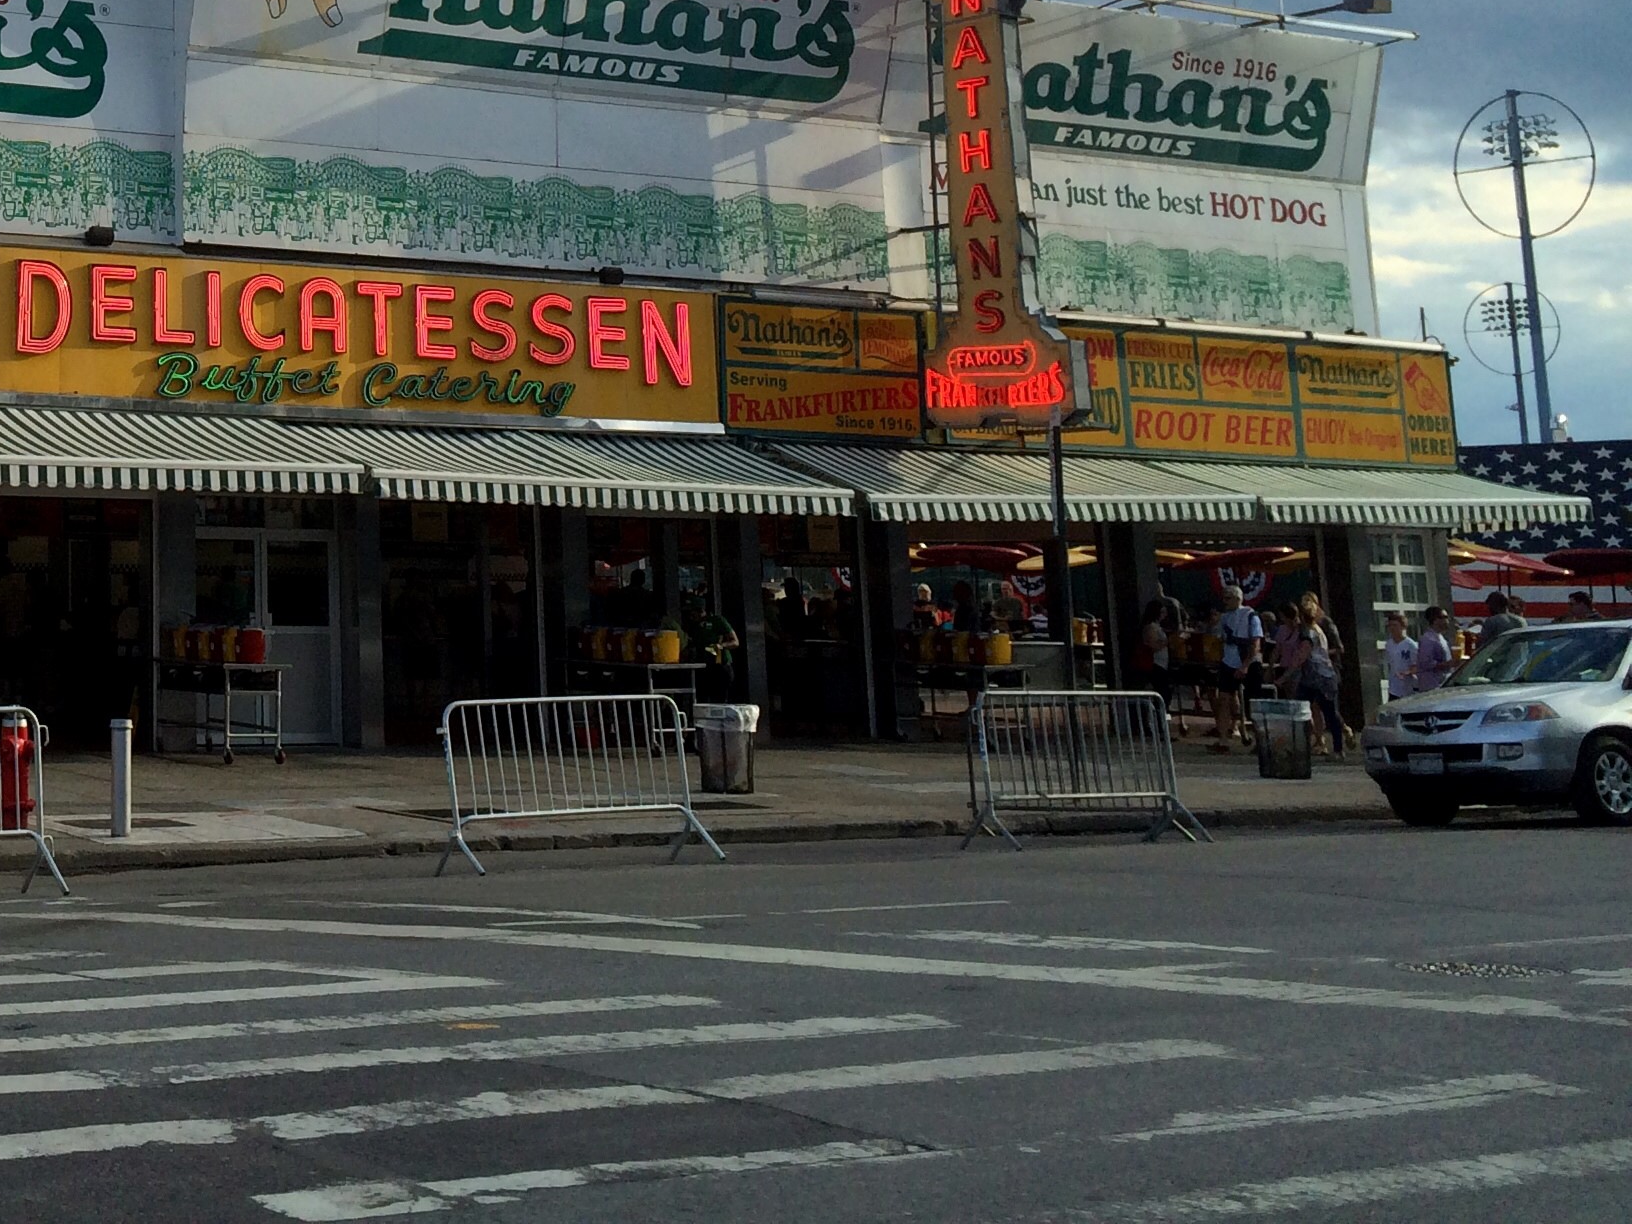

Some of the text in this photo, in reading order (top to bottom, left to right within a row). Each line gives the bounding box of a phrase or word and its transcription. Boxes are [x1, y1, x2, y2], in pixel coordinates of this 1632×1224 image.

[513, 47, 685, 84] FAMOUS
[1171, 50, 1278, 82] Since 1916
[1023, 42, 1332, 142] athan's
[1053, 126, 1196, 156] FAMOUS
[1065, 178, 1107, 208] just
[1115, 184, 1151, 211] the
[1158, 187, 1205, 216] best
[1209, 191, 1264, 221] HOT
[1270, 197, 1328, 227] DOG
[15, 257, 694, 389] DELICATESSEN
[728, 308, 850, 349] Nathan's
[956, 349, 1027, 369] FAMOUS
[1168, 343, 1194, 360] CUT
[156, 350, 577, 418] Buffet Catering
[730, 371, 788, 392] Serving
[926, 361, 1065, 409] FRANKFURTERS
[1128, 360, 1197, 392] FRIES
[728, 382, 919, 424] FRANKFURTERS
[835, 415, 875, 431] Since
[1134, 408, 1294, 448] ROOT BEER
[1306, 417, 1347, 445] ENJOY
[1407, 415, 1451, 433] ORDER
[1410, 436, 1454, 457] HERE!
